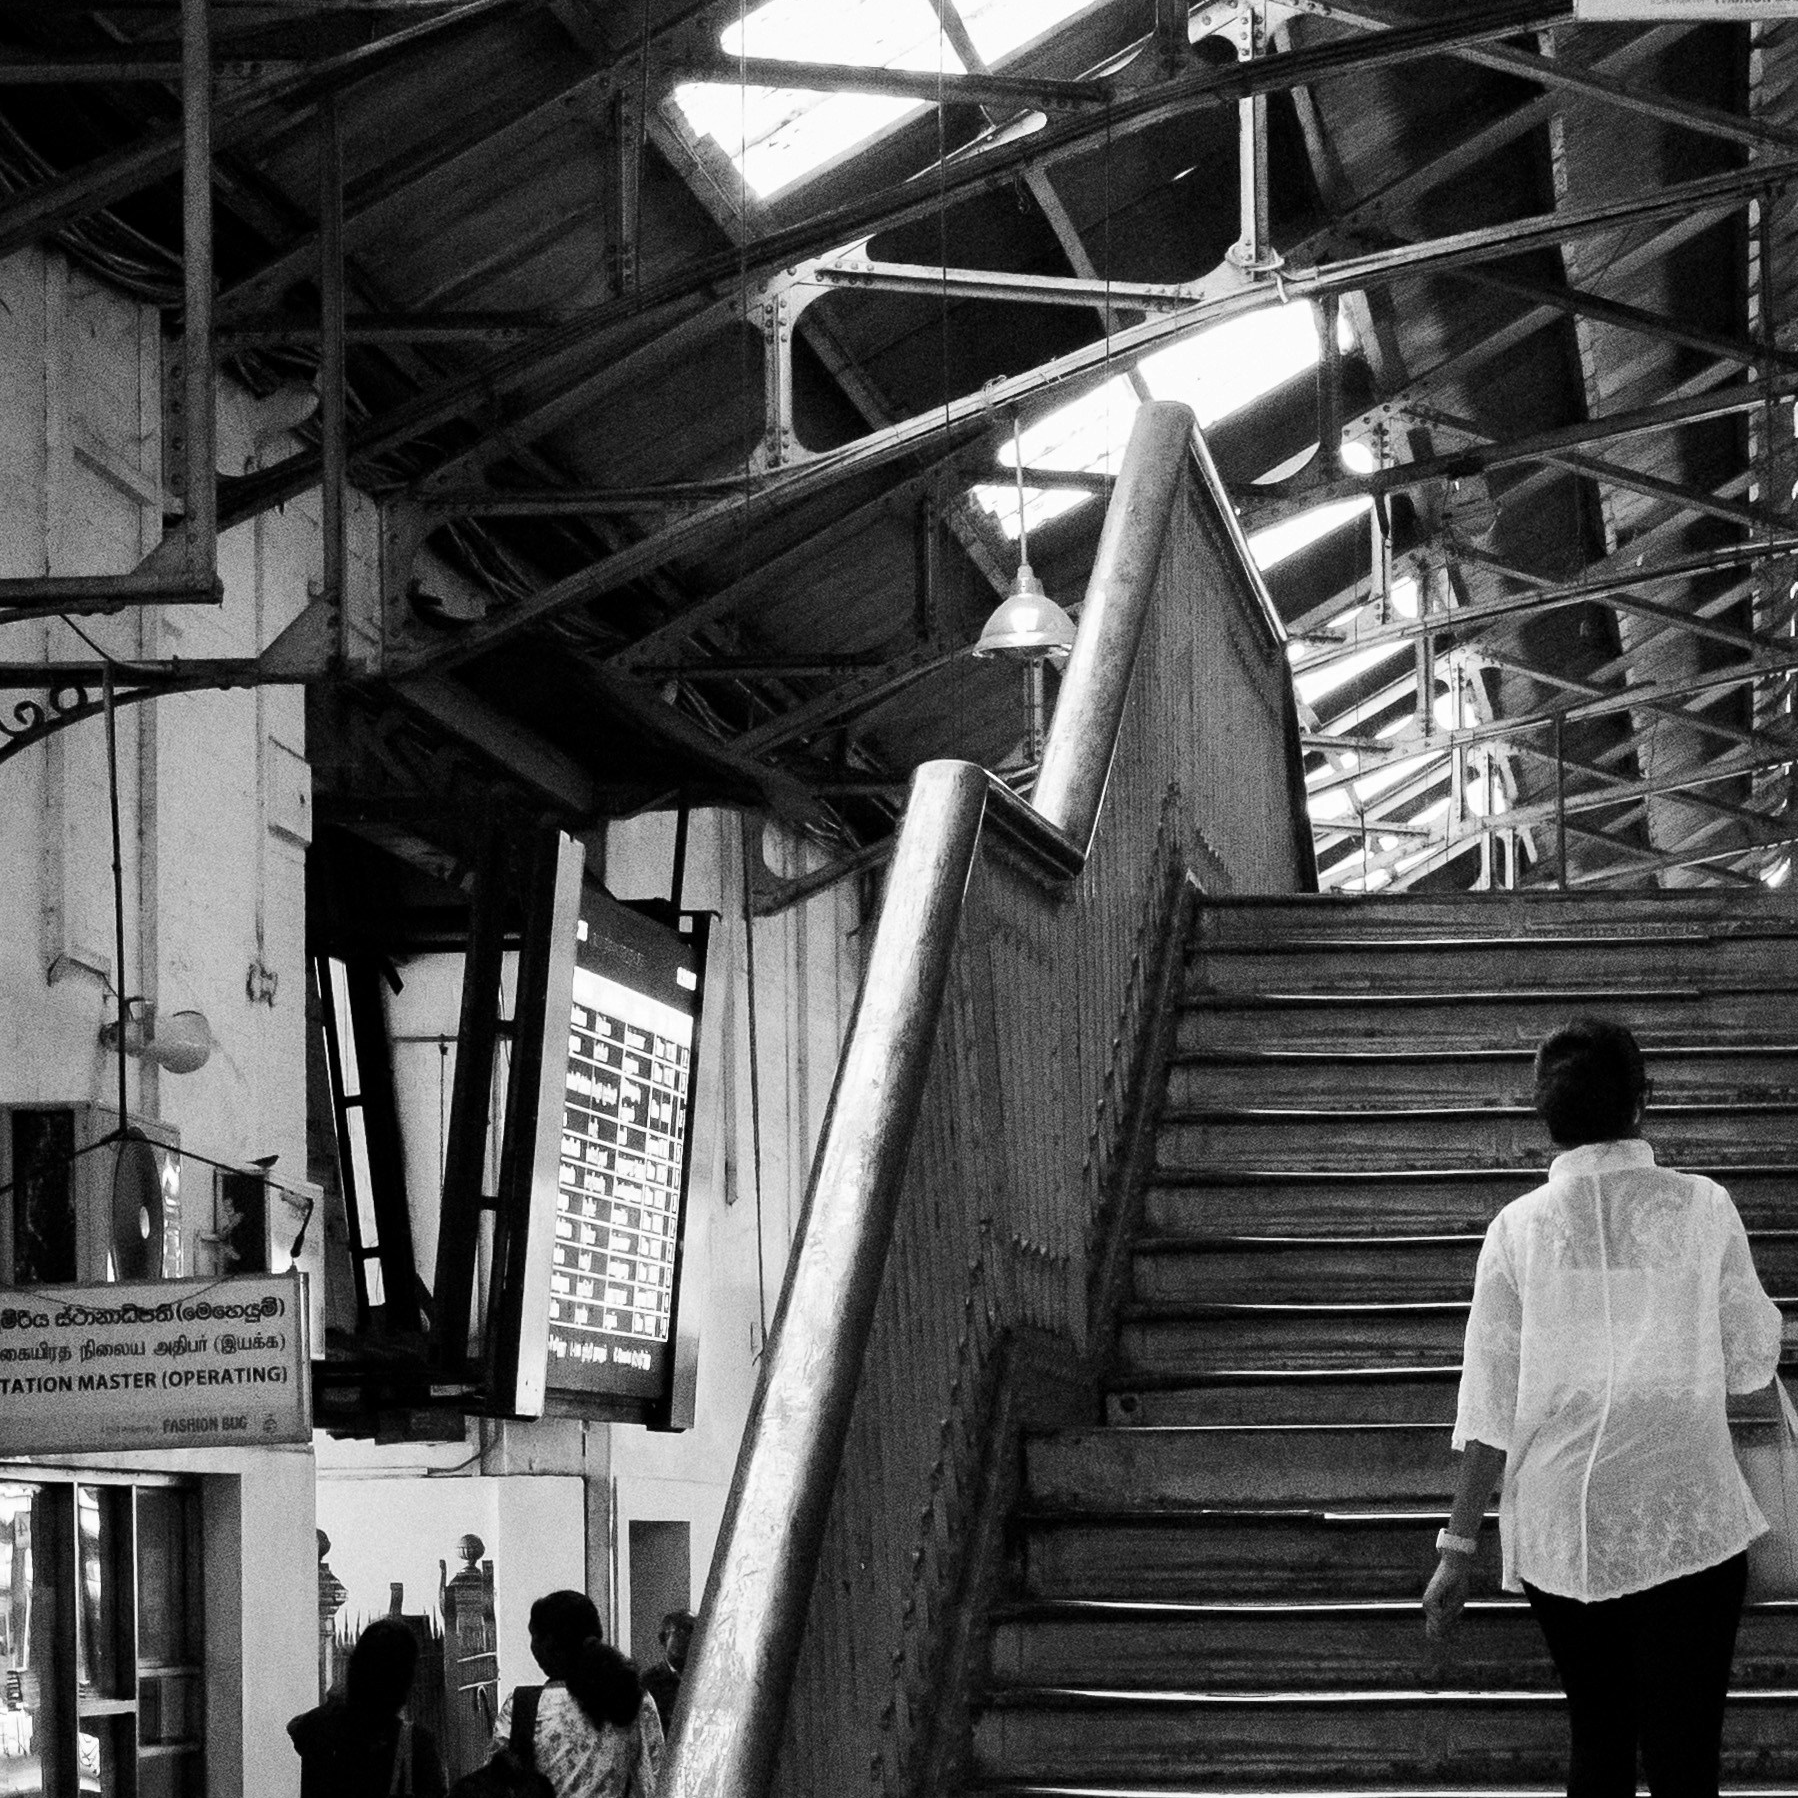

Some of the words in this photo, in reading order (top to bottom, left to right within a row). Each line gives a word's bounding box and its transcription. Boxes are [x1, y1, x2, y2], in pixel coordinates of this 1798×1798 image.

[0, 1376, 73, 1395] TATION
[78, 1372, 157, 1392] MASTER
[162, 1365, 288, 1390] (OPERATING)
[163, 1416, 219, 1434] FASHION
[222, 1415, 249, 1431] BUG
